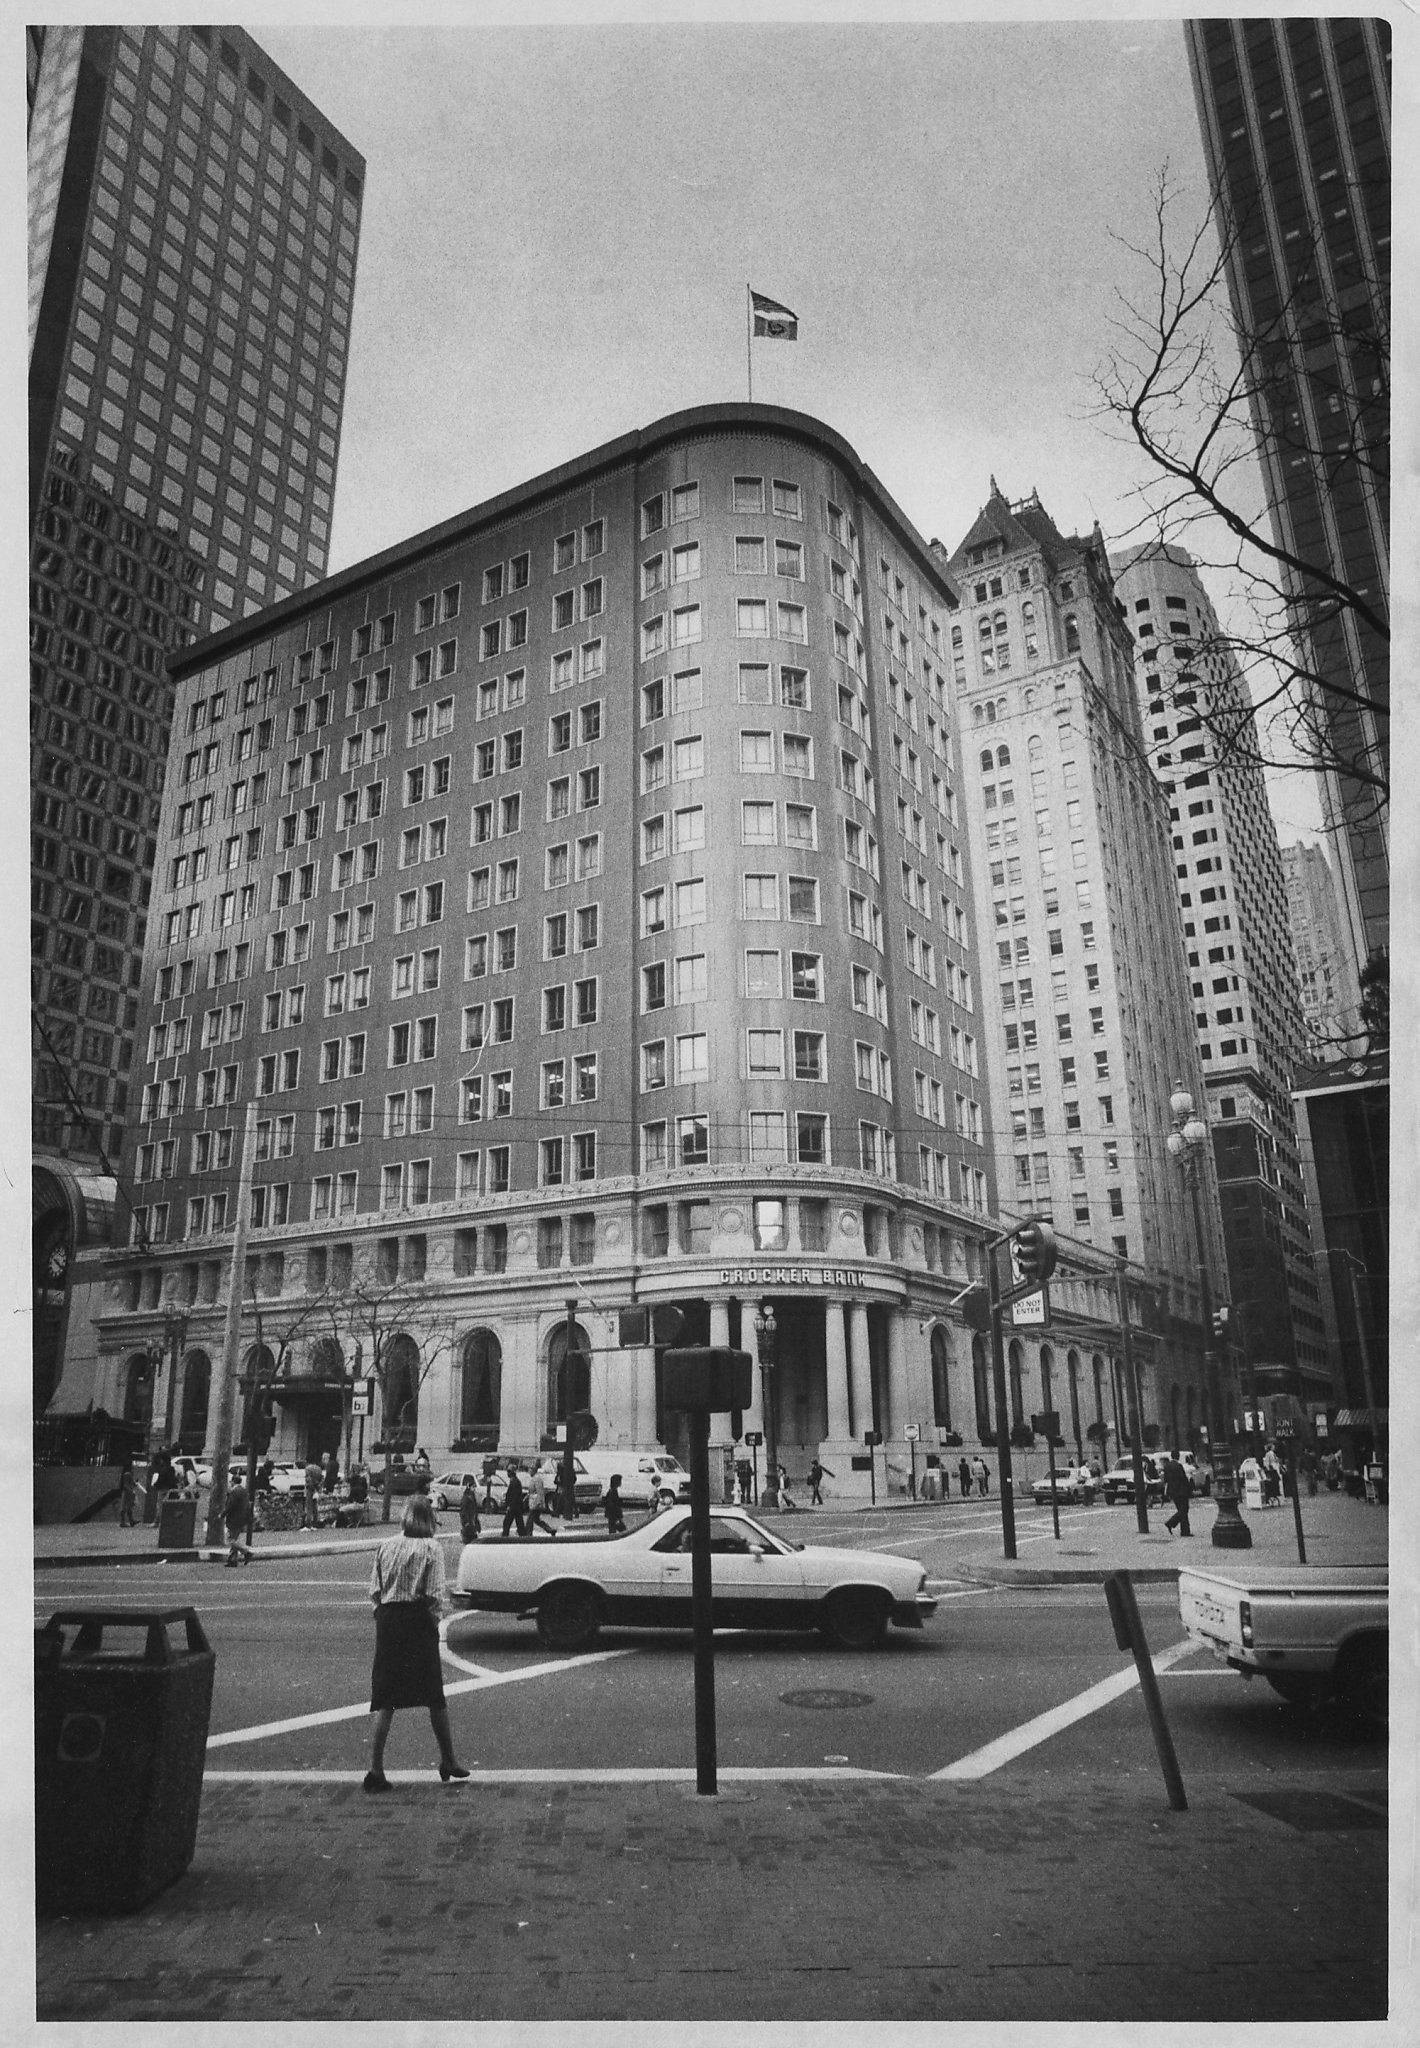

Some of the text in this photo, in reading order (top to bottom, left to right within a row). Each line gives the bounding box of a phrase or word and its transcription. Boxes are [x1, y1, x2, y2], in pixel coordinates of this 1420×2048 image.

[720, 1268, 866, 1287] CROCKER BANK
[1016, 1307, 1040, 1315] ENTER
[1276, 1428, 1295, 1437] WALK
